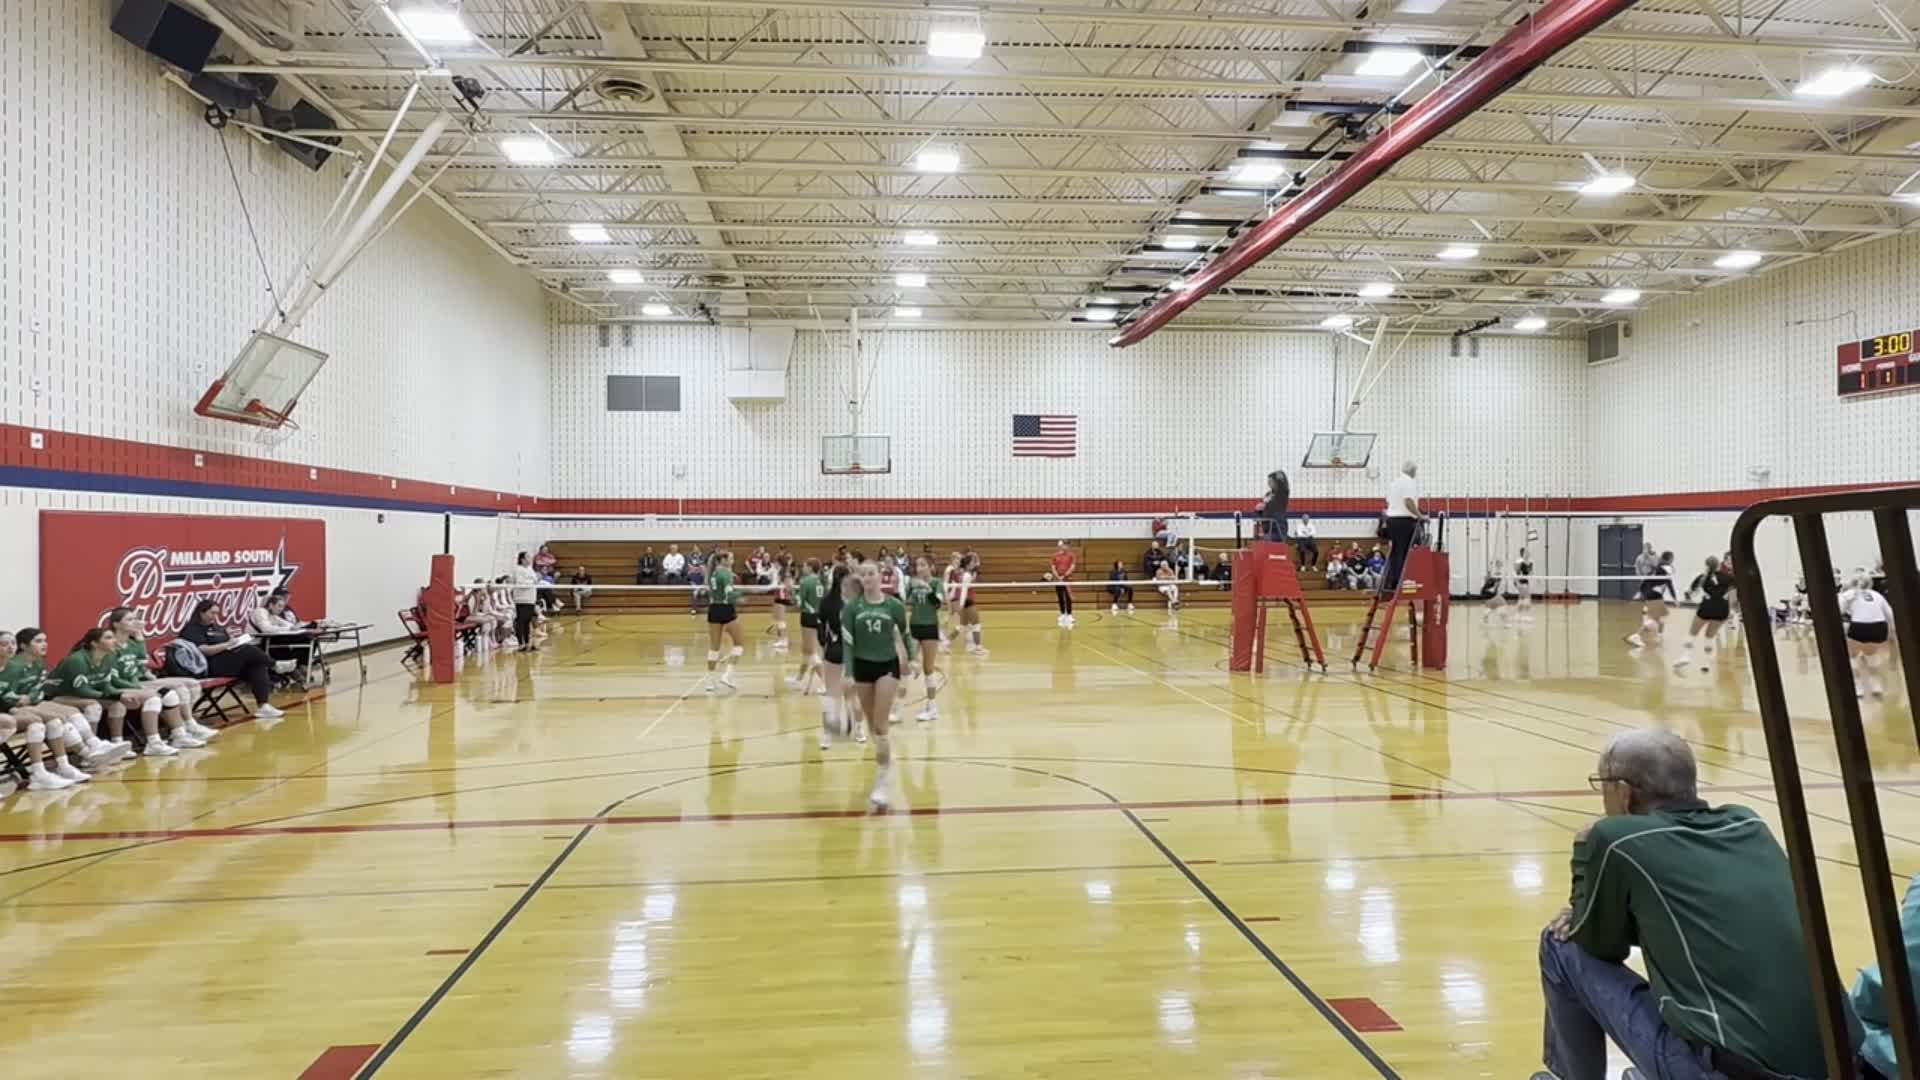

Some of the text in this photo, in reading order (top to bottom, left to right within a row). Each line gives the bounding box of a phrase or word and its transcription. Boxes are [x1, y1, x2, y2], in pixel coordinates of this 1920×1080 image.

[1873, 333, 1910, 357] 3:00
[170, 549, 274, 566] MILLARD SOUTH
[865, 619, 882, 634] 14
